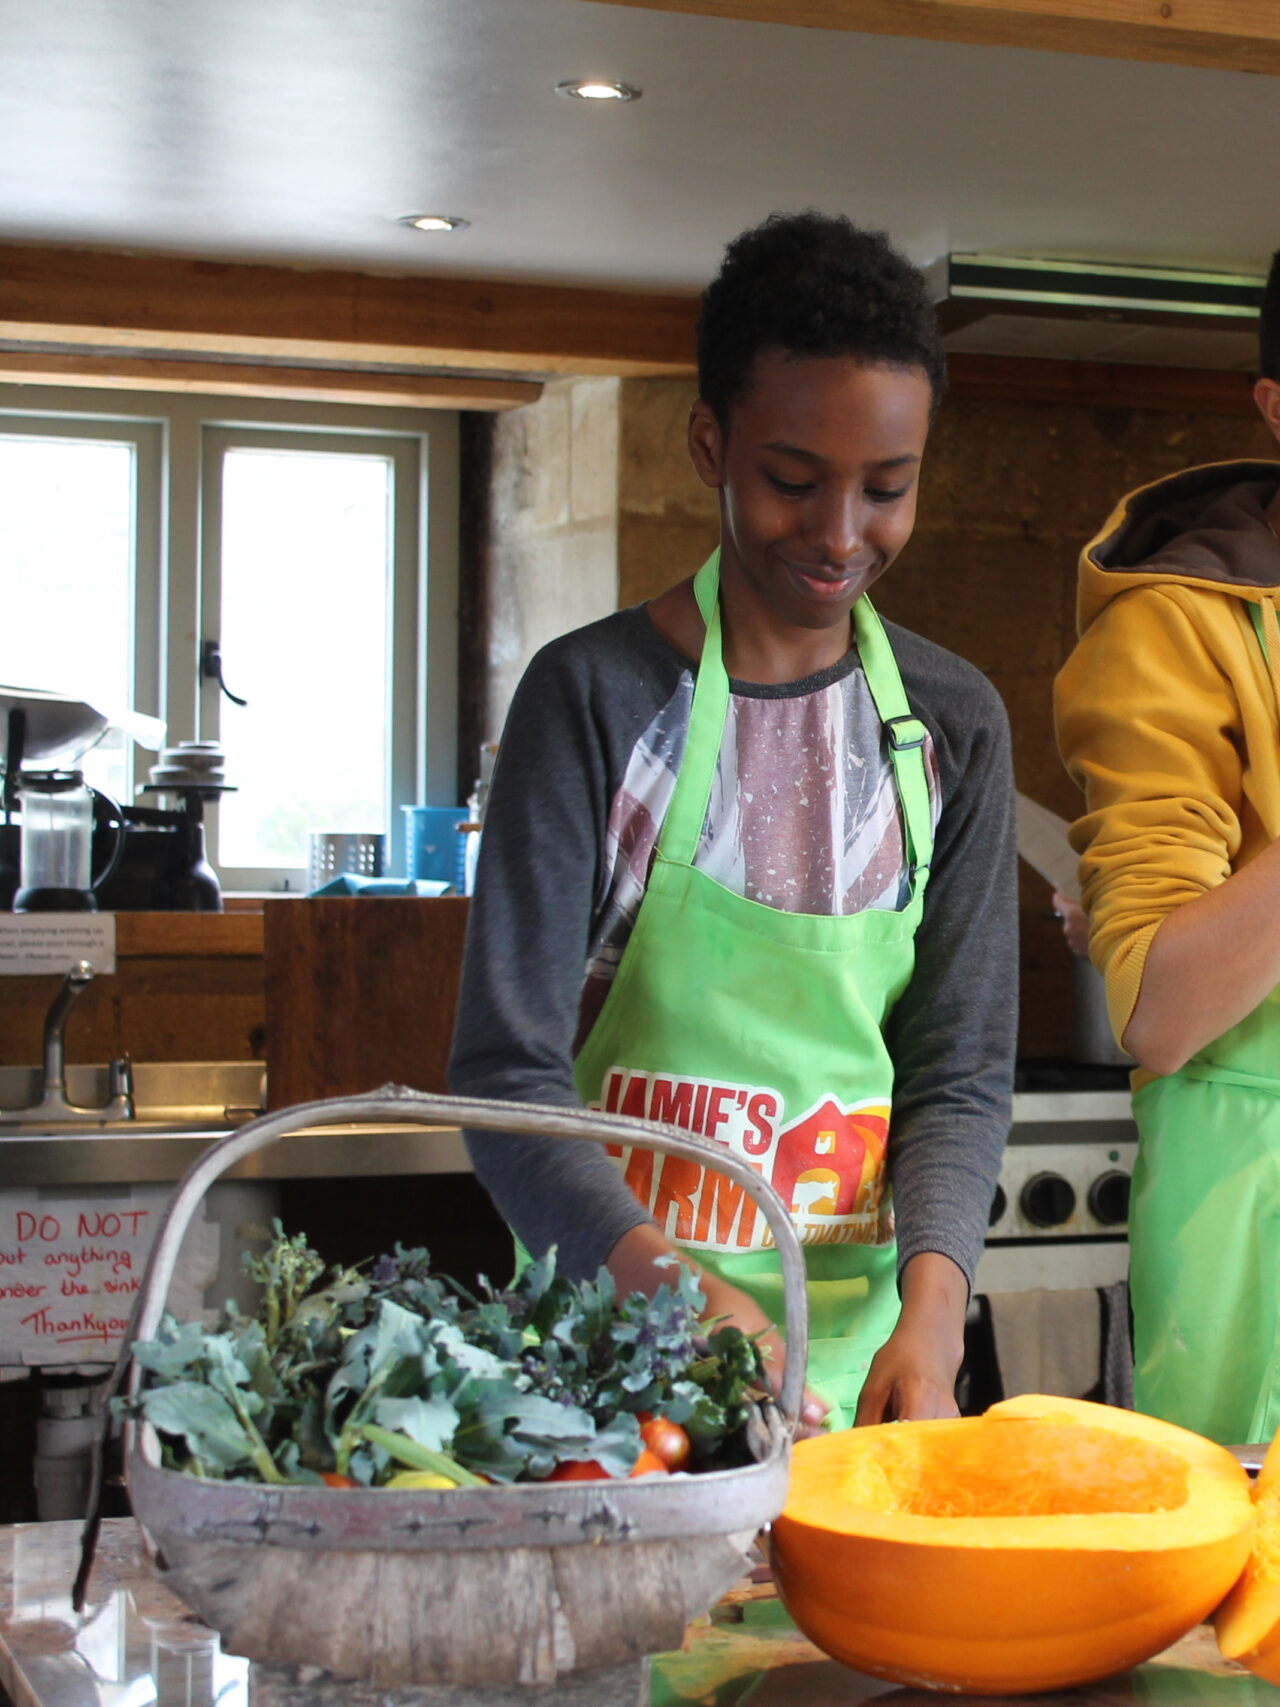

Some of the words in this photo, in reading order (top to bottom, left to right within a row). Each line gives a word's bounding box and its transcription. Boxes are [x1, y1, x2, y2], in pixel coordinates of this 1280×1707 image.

[604, 1143, 763, 1248] ARM
[16, 1211, 60, 1242] DO
[78, 1210, 149, 1238] NOT
[44, 1246, 132, 1277] anything
[60, 1279, 89, 1296] the
